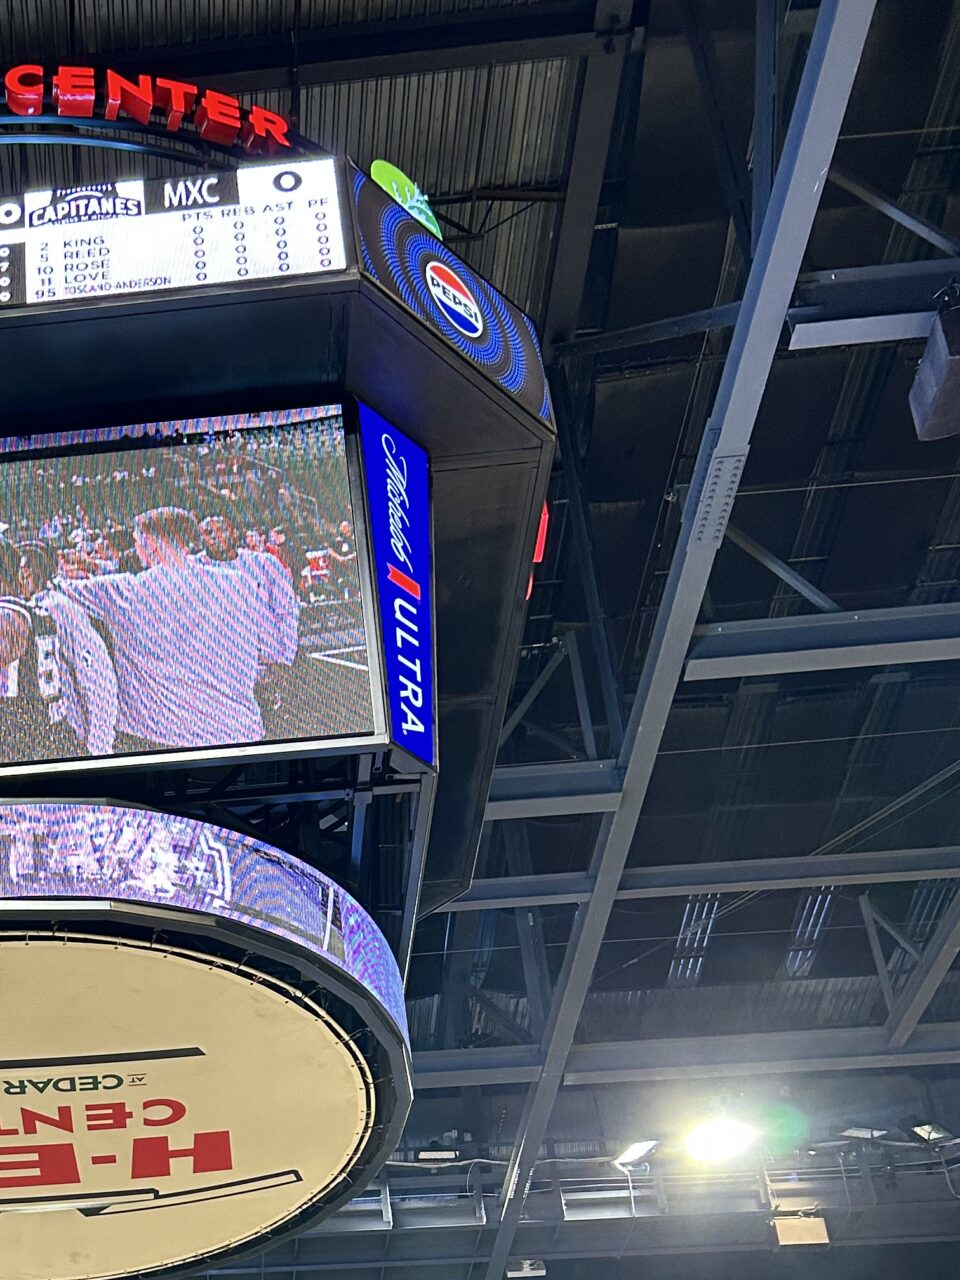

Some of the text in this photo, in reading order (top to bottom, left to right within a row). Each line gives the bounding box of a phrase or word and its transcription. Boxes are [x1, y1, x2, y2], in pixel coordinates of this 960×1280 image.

[4, 64, 293, 152] CENTER
[163, 170, 302, 208] MXC 0
[30, 197, 141, 227] CAPITANES
[182, 197, 328, 222] PTS REB AST PF
[63, 236, 105, 248] KING
[63, 247, 110, 260] REED
[0, 262, 10, 272] 7
[36, 260, 110, 275] 10 ROSE
[40, 271, 110, 287] 11 LOVE
[34, 276, 172, 298] 95 TOSCANO-ANDERSON
[430, 275, 480, 324] PEPSI
[381, 432, 414, 573] Michelob
[393, 597, 426, 736] ULTRA
[3, 1072, 124, 1096] CEDAR
[129, 1075, 147, 1085] AT
